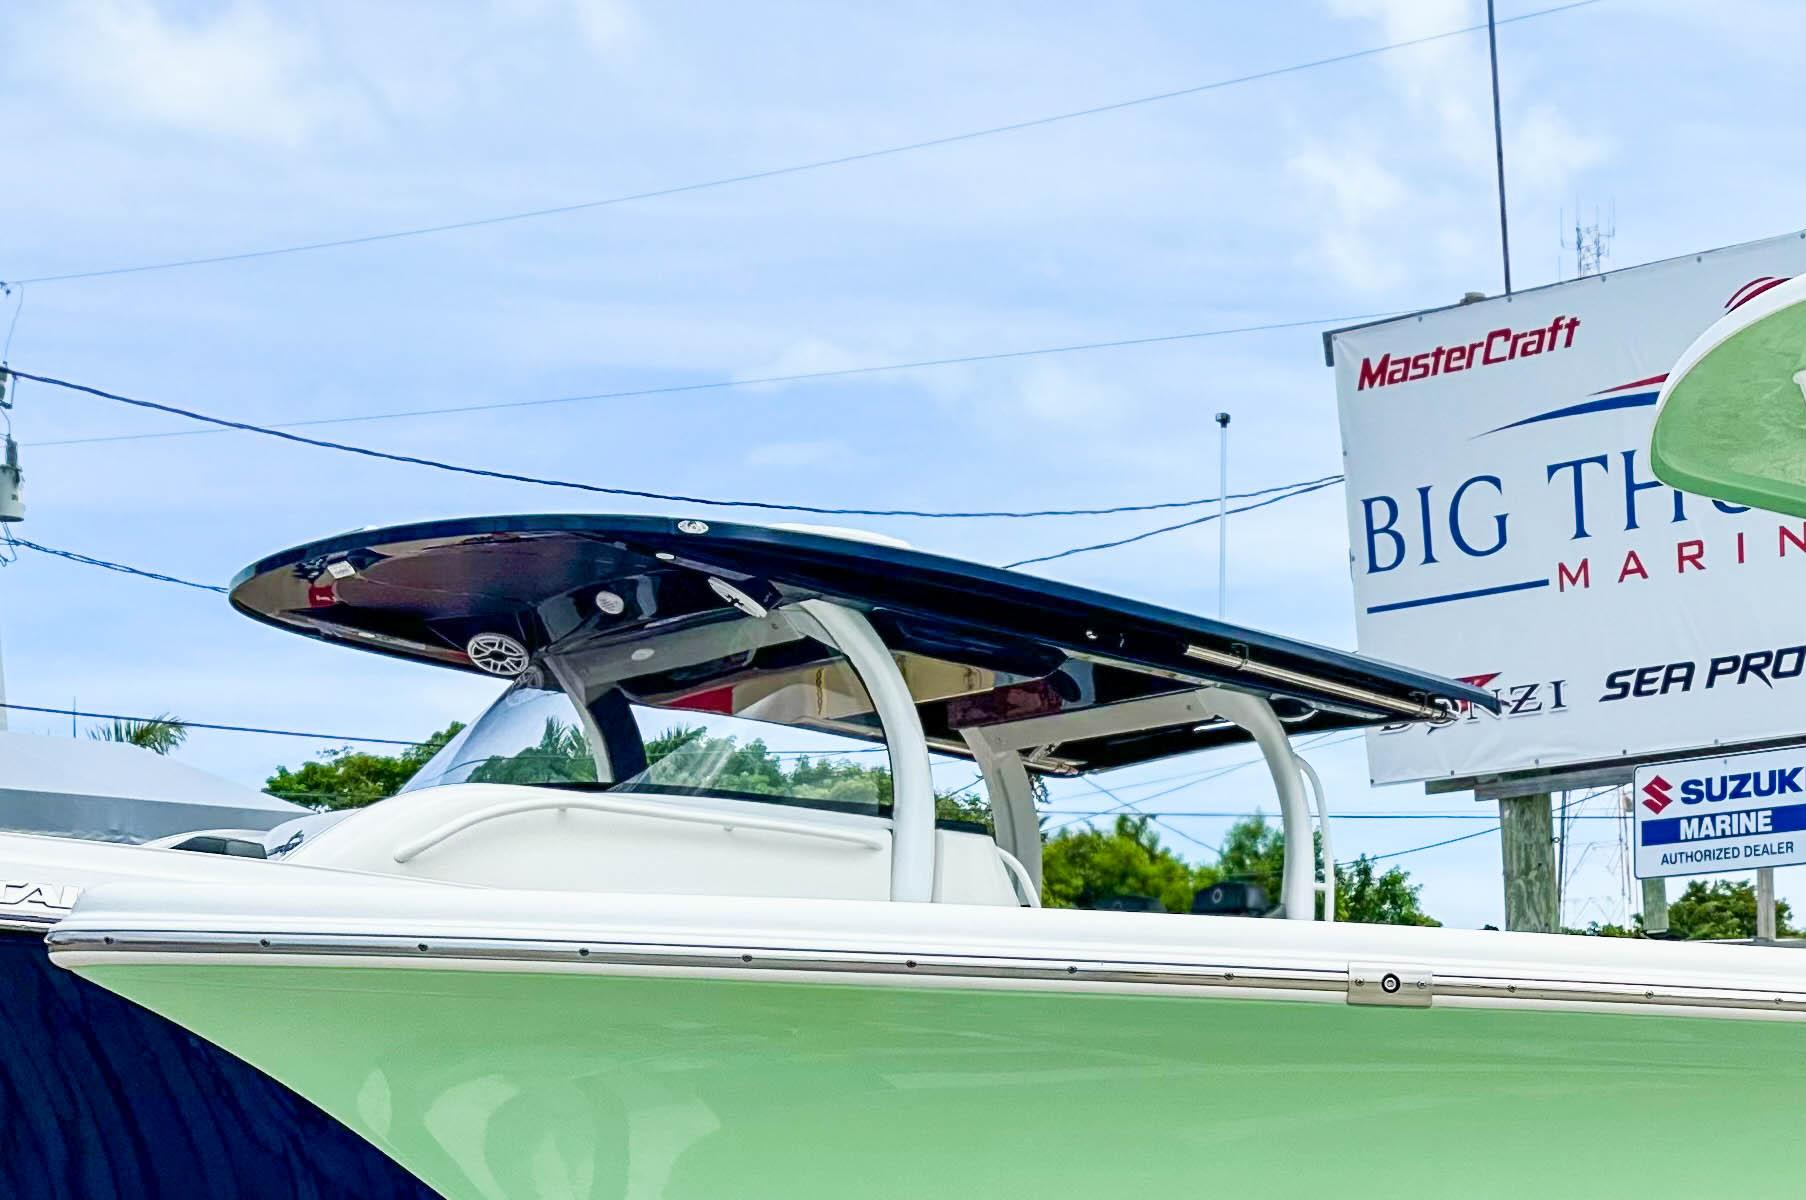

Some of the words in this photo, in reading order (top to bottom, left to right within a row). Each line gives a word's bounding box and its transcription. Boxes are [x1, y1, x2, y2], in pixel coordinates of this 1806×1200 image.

[1357, 315, 1581, 391] MasterCraft
[1360, 475, 1509, 574] BIG
[1599, 661, 1695, 702] SEA
[1705, 645, 1806, 689] PRO
[1660, 845, 1740, 866] AUTHORIZED
[1744, 841, 1794, 858] DEALER
[1680, 810, 1773, 840] MARINE
